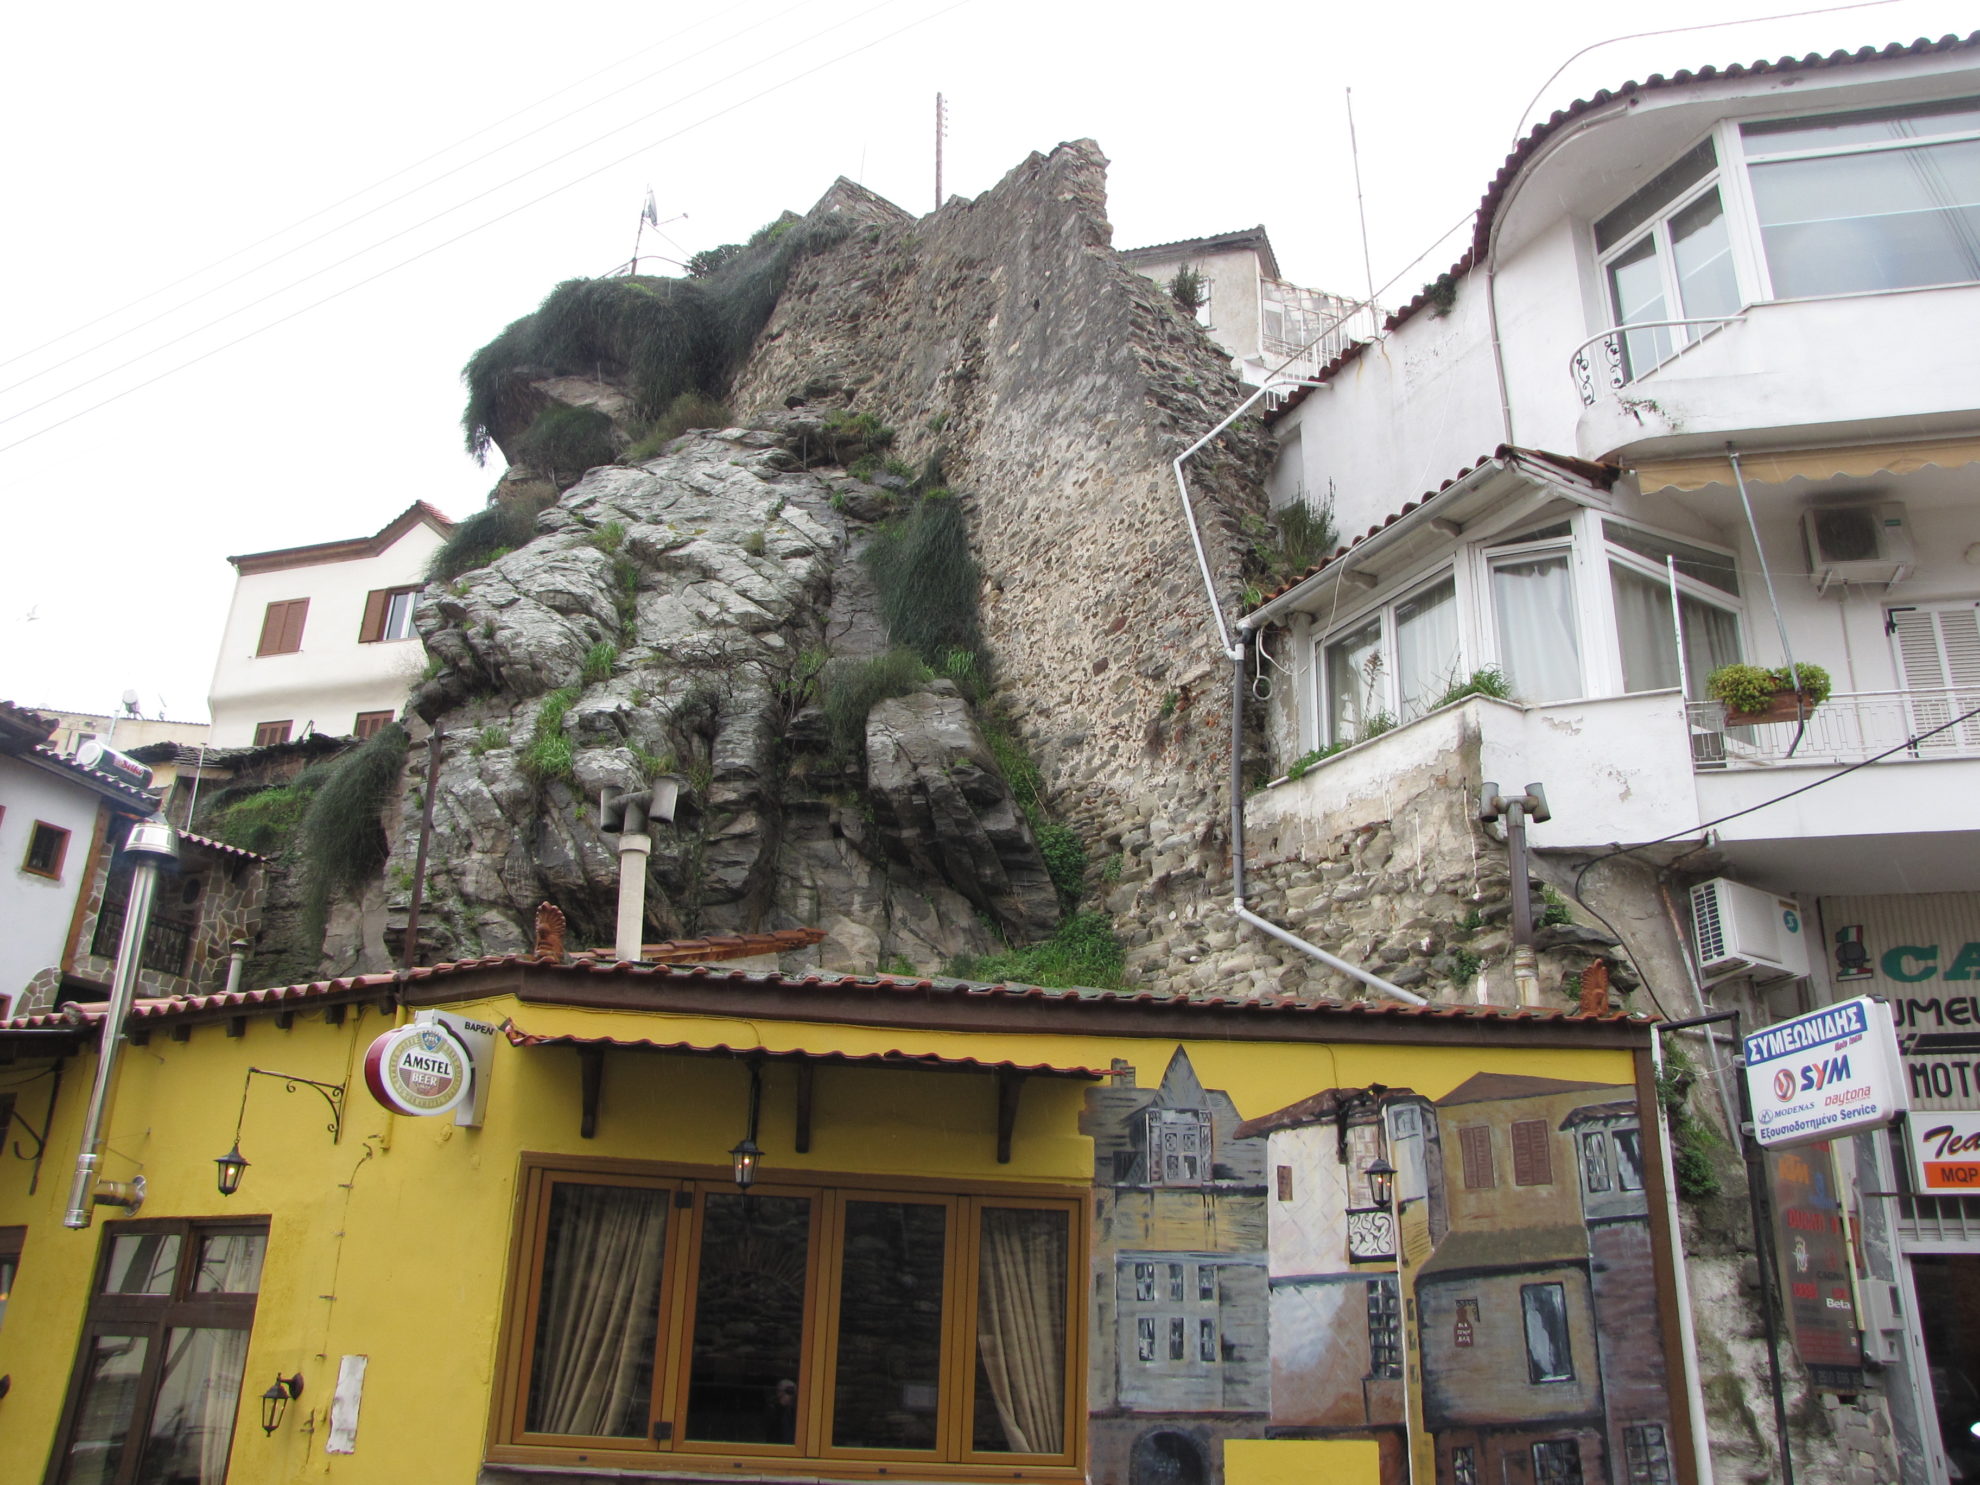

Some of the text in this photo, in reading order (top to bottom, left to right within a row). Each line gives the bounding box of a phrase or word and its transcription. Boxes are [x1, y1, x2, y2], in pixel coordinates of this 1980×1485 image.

[1748, 1006, 1861, 1062] ΣΥΜΕΩΝΙΔΗΣ
[403, 1052, 450, 1075] AMSTEL
[1800, 1054, 1851, 1091] SYM
[412, 1072, 437, 1086] BEER
[1824, 1086, 1871, 1106] Daytona
[1774, 1102, 1815, 1118] MODENAS
[1760, 1104, 1877, 1140] Εξουσιοδοτημένο Service
[1826, 1298, 1851, 1309] Beta
